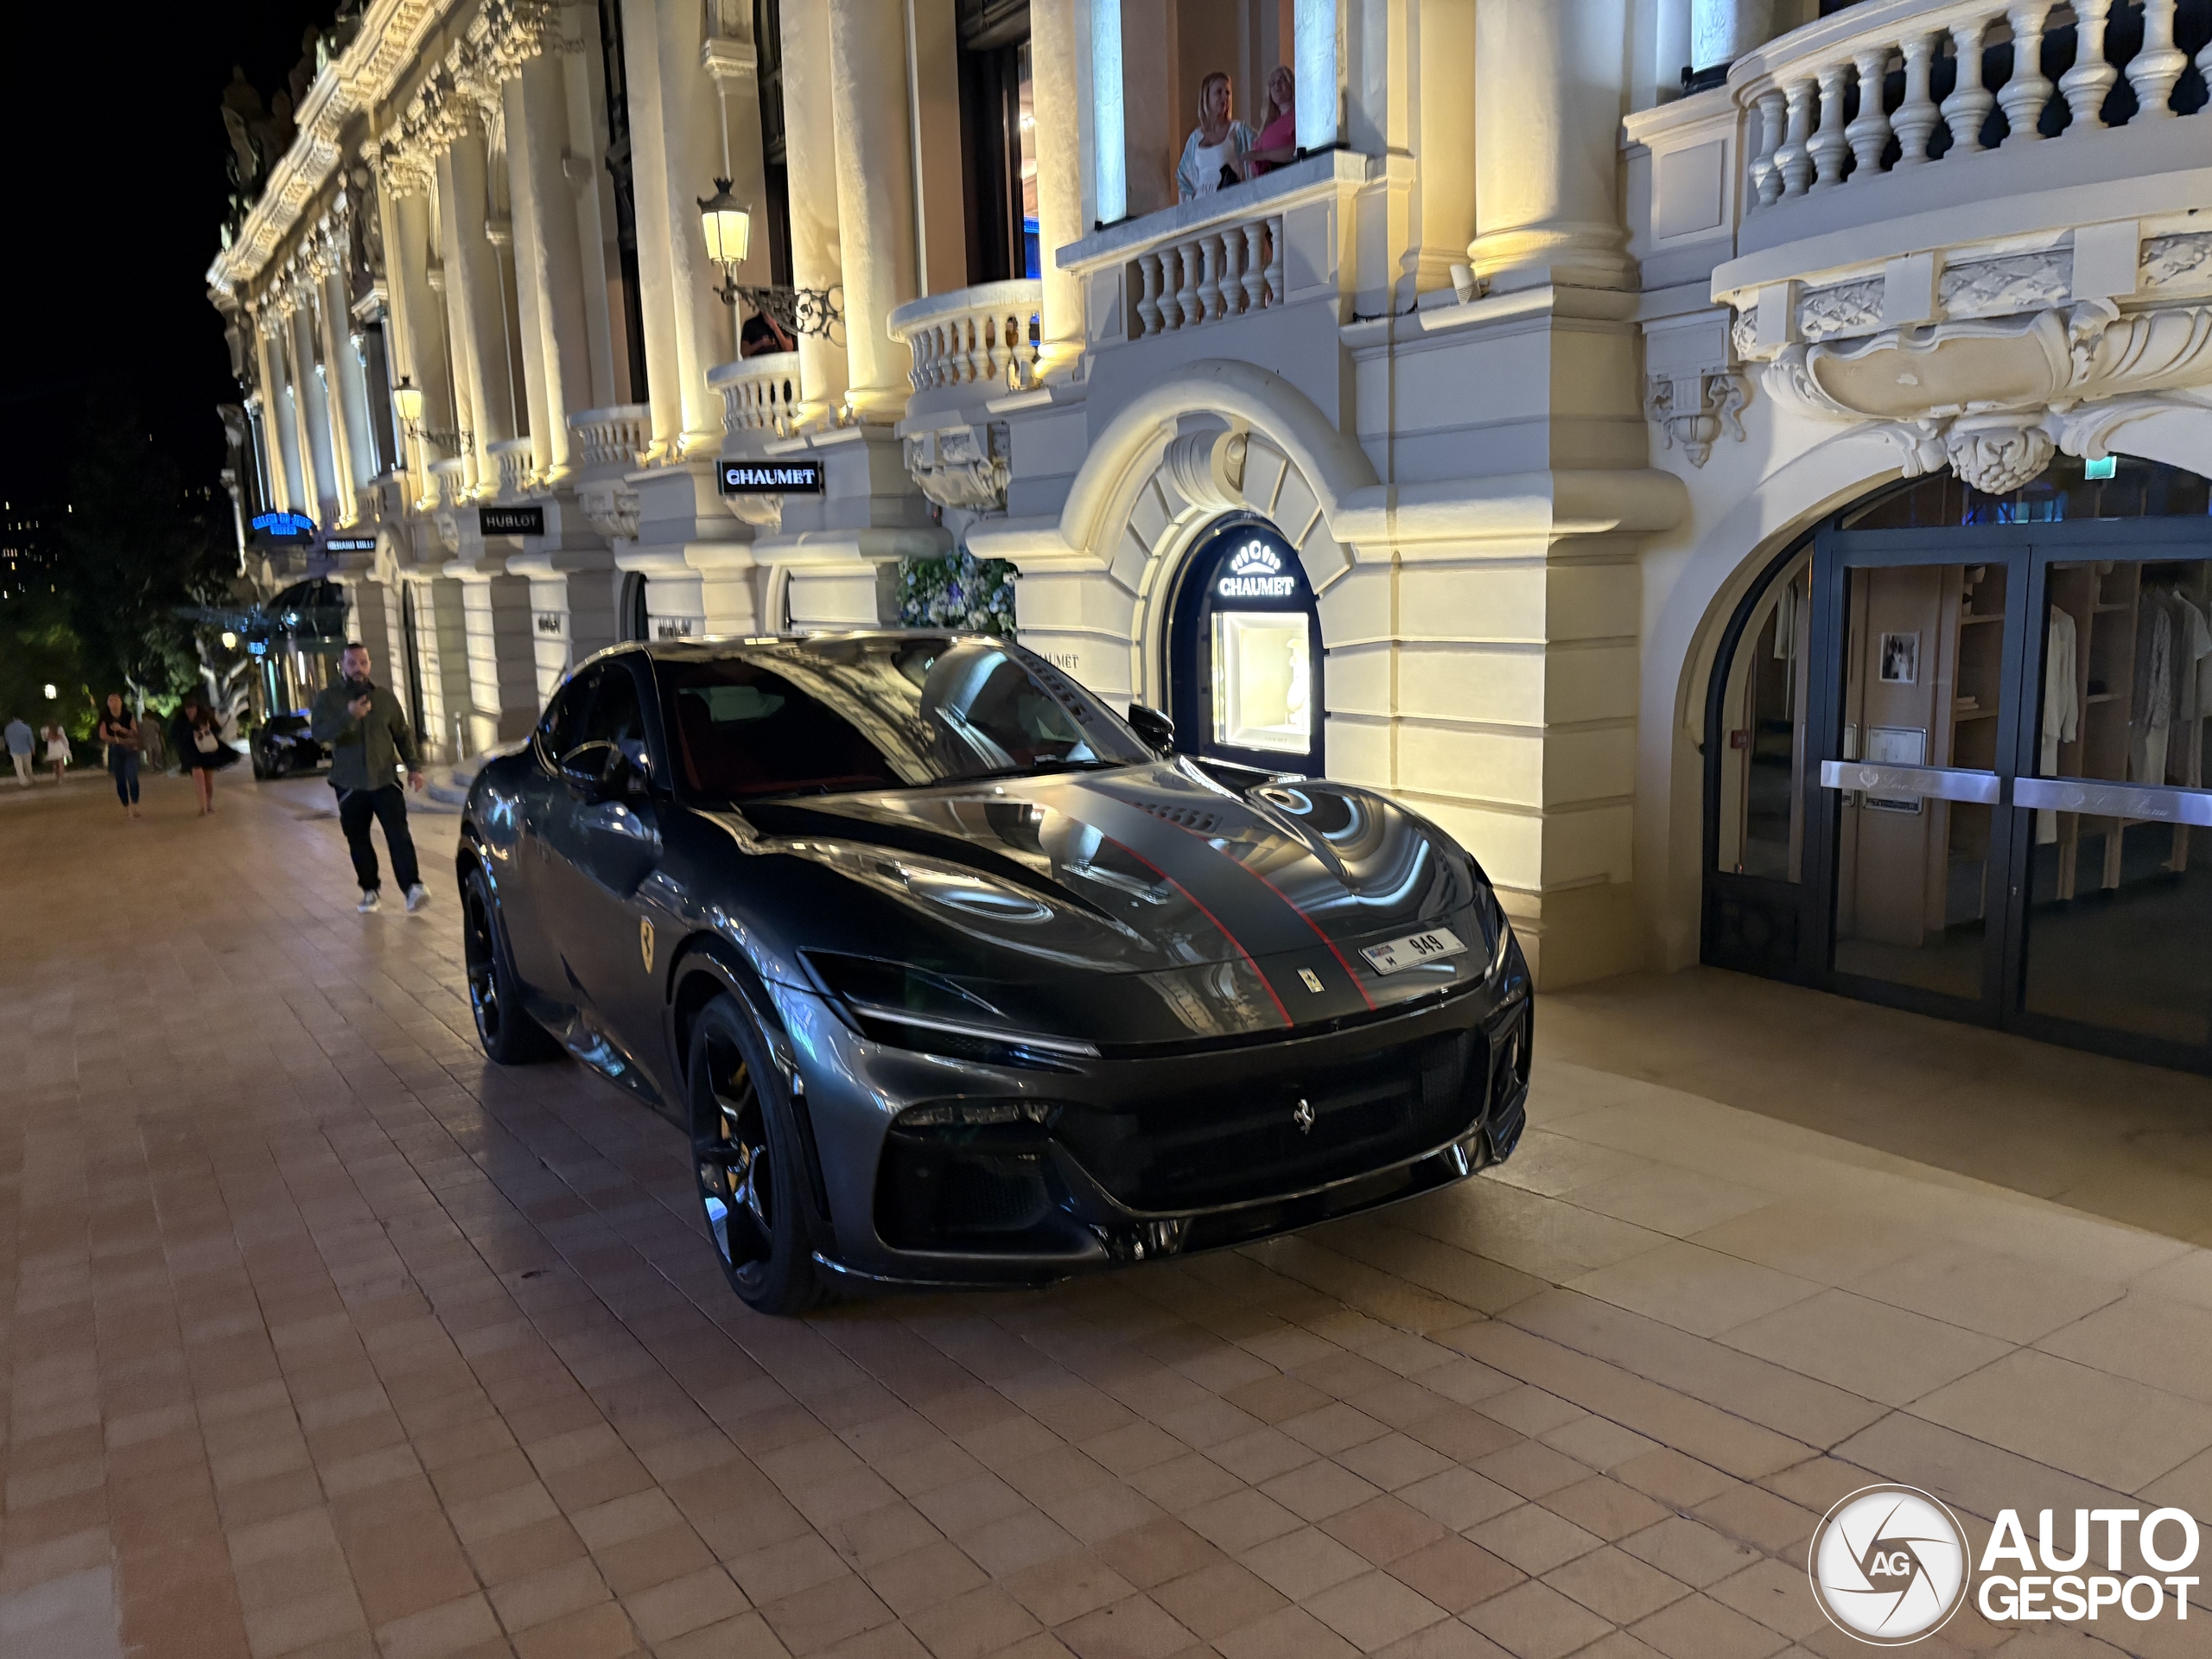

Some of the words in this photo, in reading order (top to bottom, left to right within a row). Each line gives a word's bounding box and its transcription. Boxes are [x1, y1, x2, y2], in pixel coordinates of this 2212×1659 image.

[726, 468, 815, 486] CHAUMET
[486, 514, 537, 528] HUBLOT
[1219, 577, 1294, 596] CHAUMET
[1040, 652, 1079, 669] AUMET
[1408, 934, 1445, 956] 949
